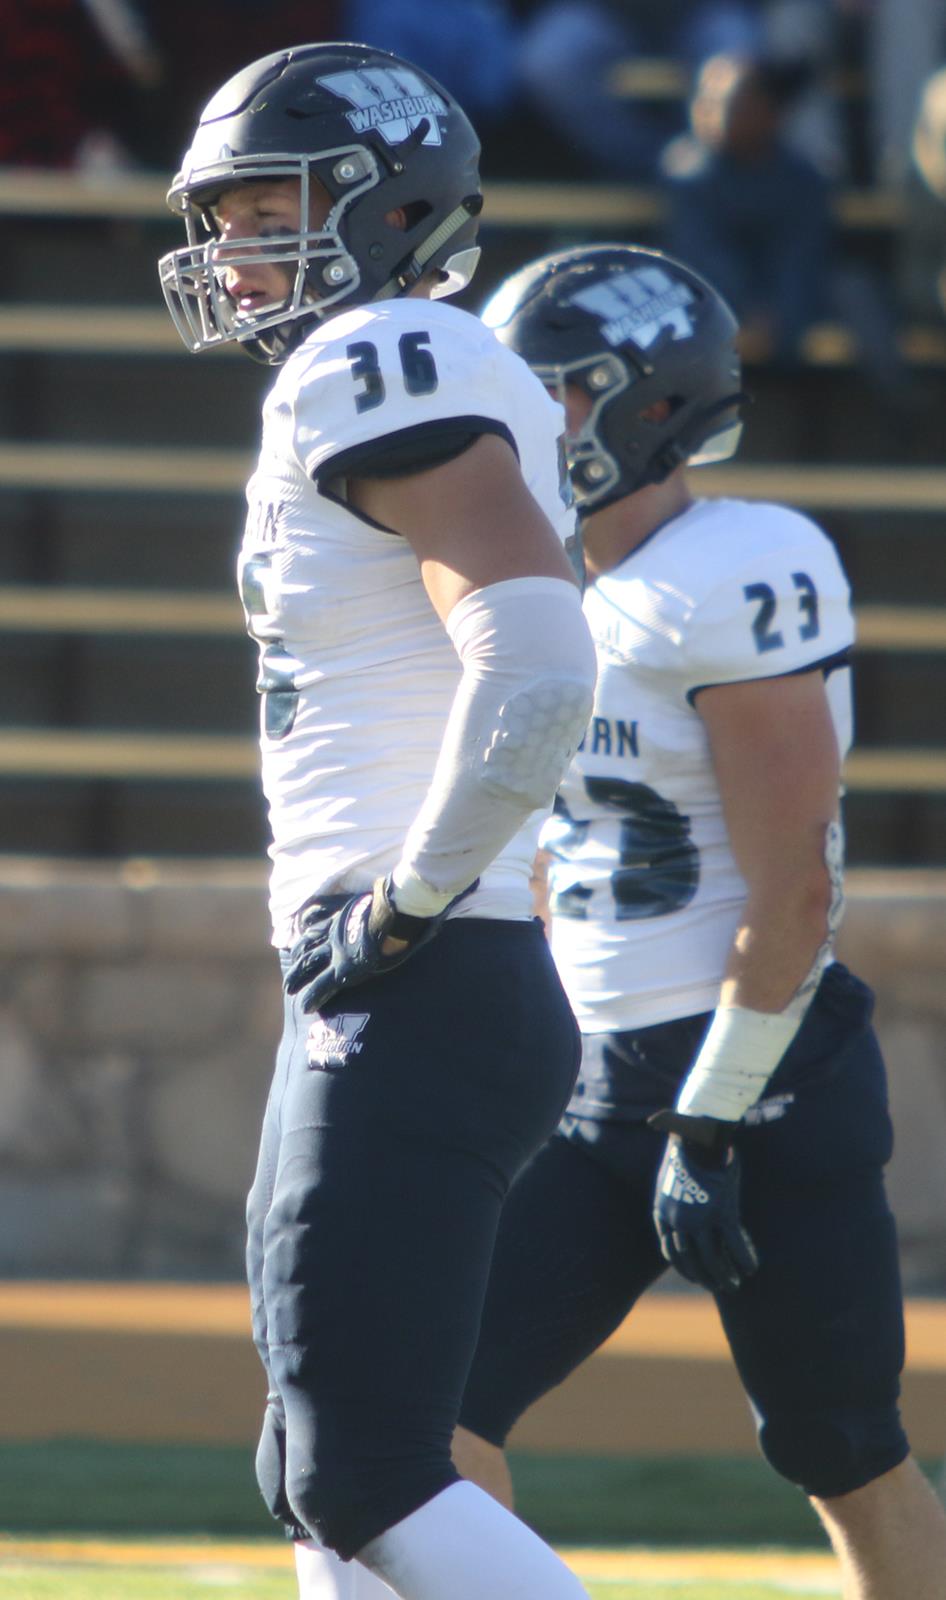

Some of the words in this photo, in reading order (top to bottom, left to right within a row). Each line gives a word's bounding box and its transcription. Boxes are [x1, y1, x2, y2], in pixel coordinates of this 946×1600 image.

[347, 95, 447, 131] WASHBURN
[346, 331, 439, 415] 36
[743, 571, 820, 656] 23
[577, 717, 640, 758] RN
